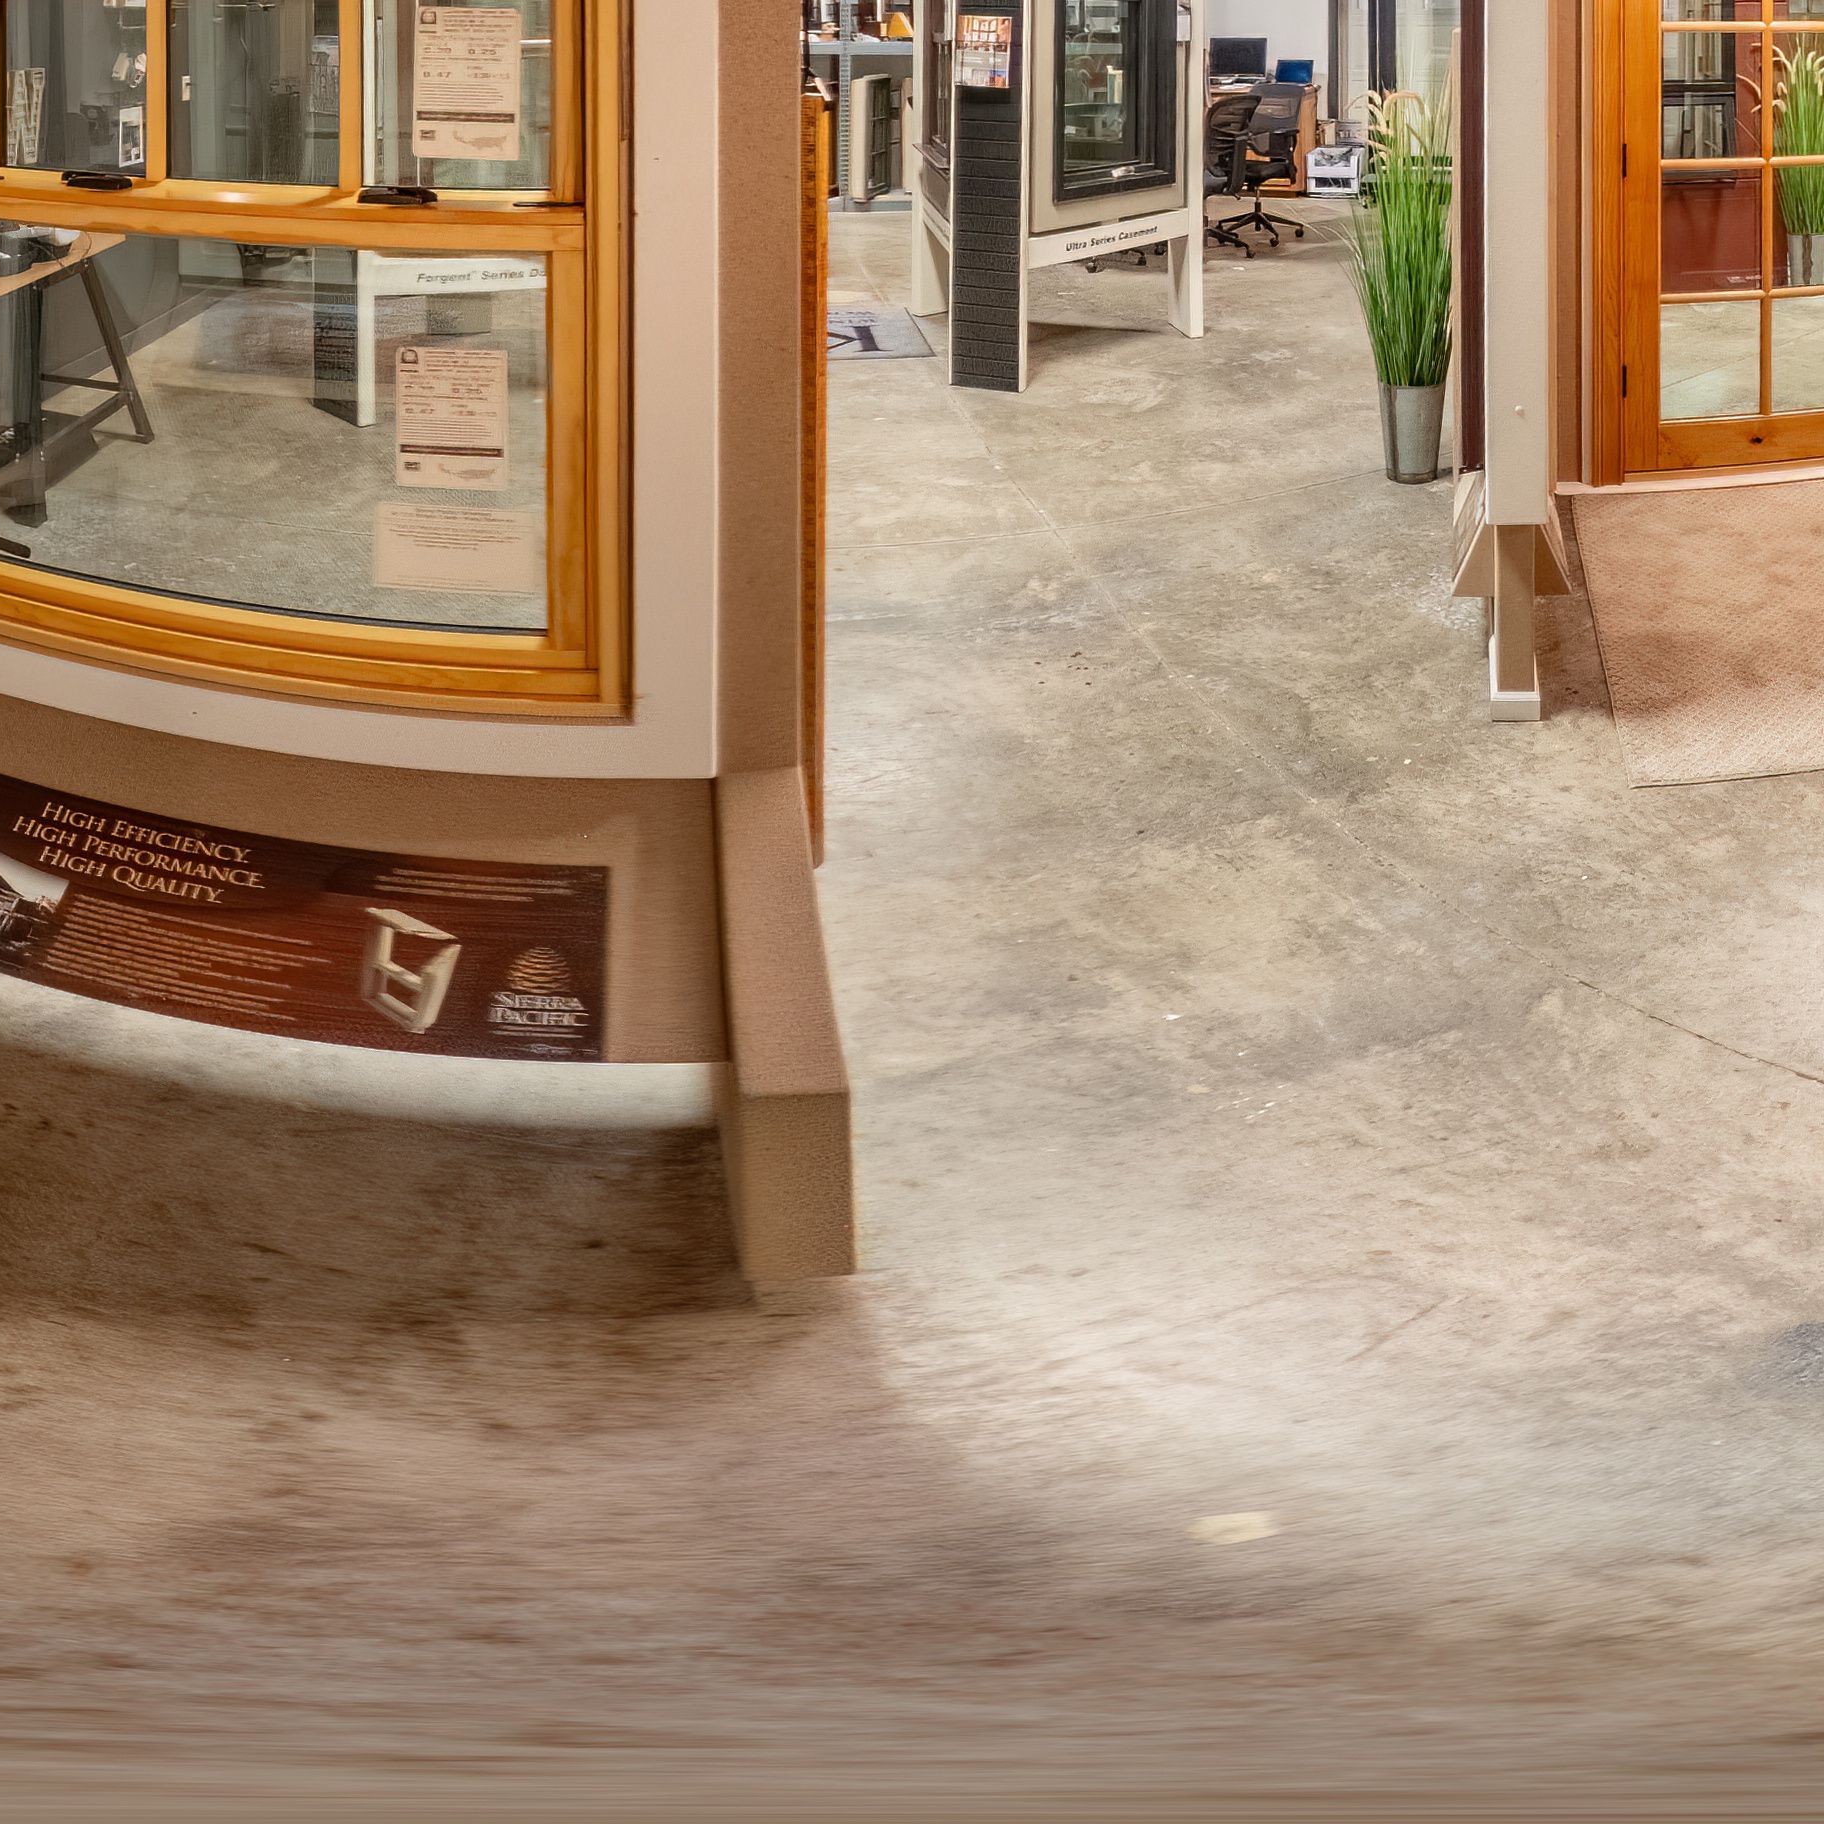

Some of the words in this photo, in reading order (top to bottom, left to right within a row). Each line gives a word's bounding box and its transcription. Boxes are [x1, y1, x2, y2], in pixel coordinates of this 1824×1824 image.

[1065, 242, 1087, 252] Ultra
[1090, 236, 1116, 247] Series
[1118, 226, 1158, 240] Casement
[13, 816, 75, 846] HIGH
[42, 802, 106, 832] HIGH
[38, 846, 106, 877] HIGH
